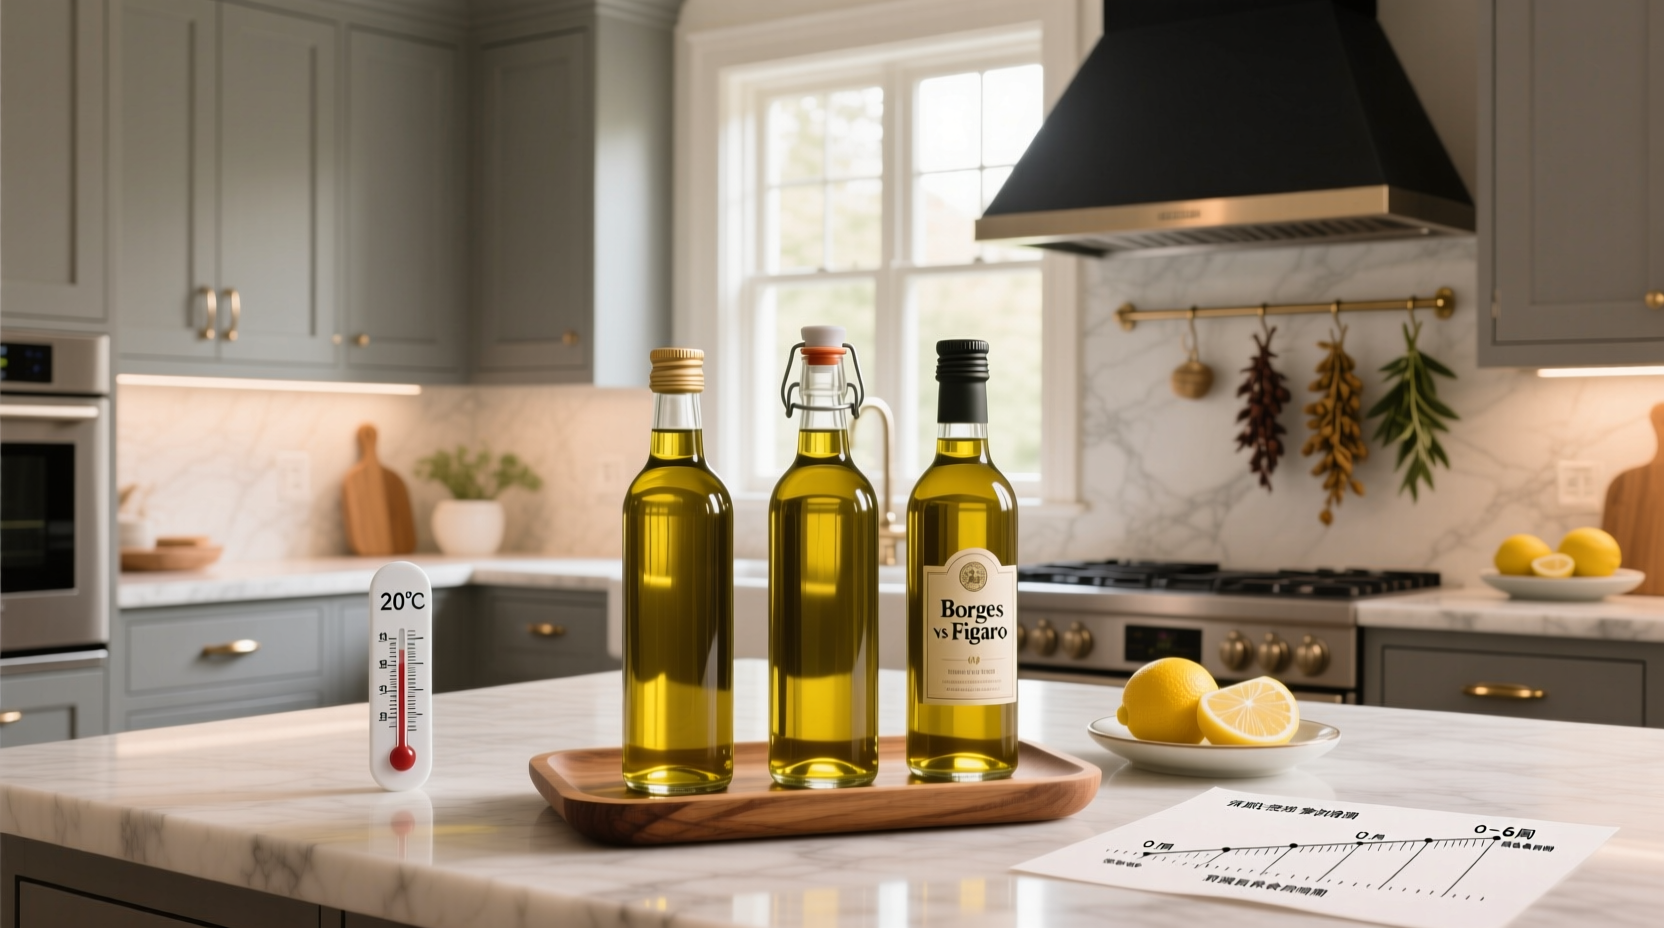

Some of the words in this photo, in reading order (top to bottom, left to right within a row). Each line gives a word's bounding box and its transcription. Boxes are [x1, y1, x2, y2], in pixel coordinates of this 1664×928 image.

[380, 592, 425, 610] 20°C
[941, 599, 1004, 624] Borges
[951, 622, 1008, 645] Figaro
